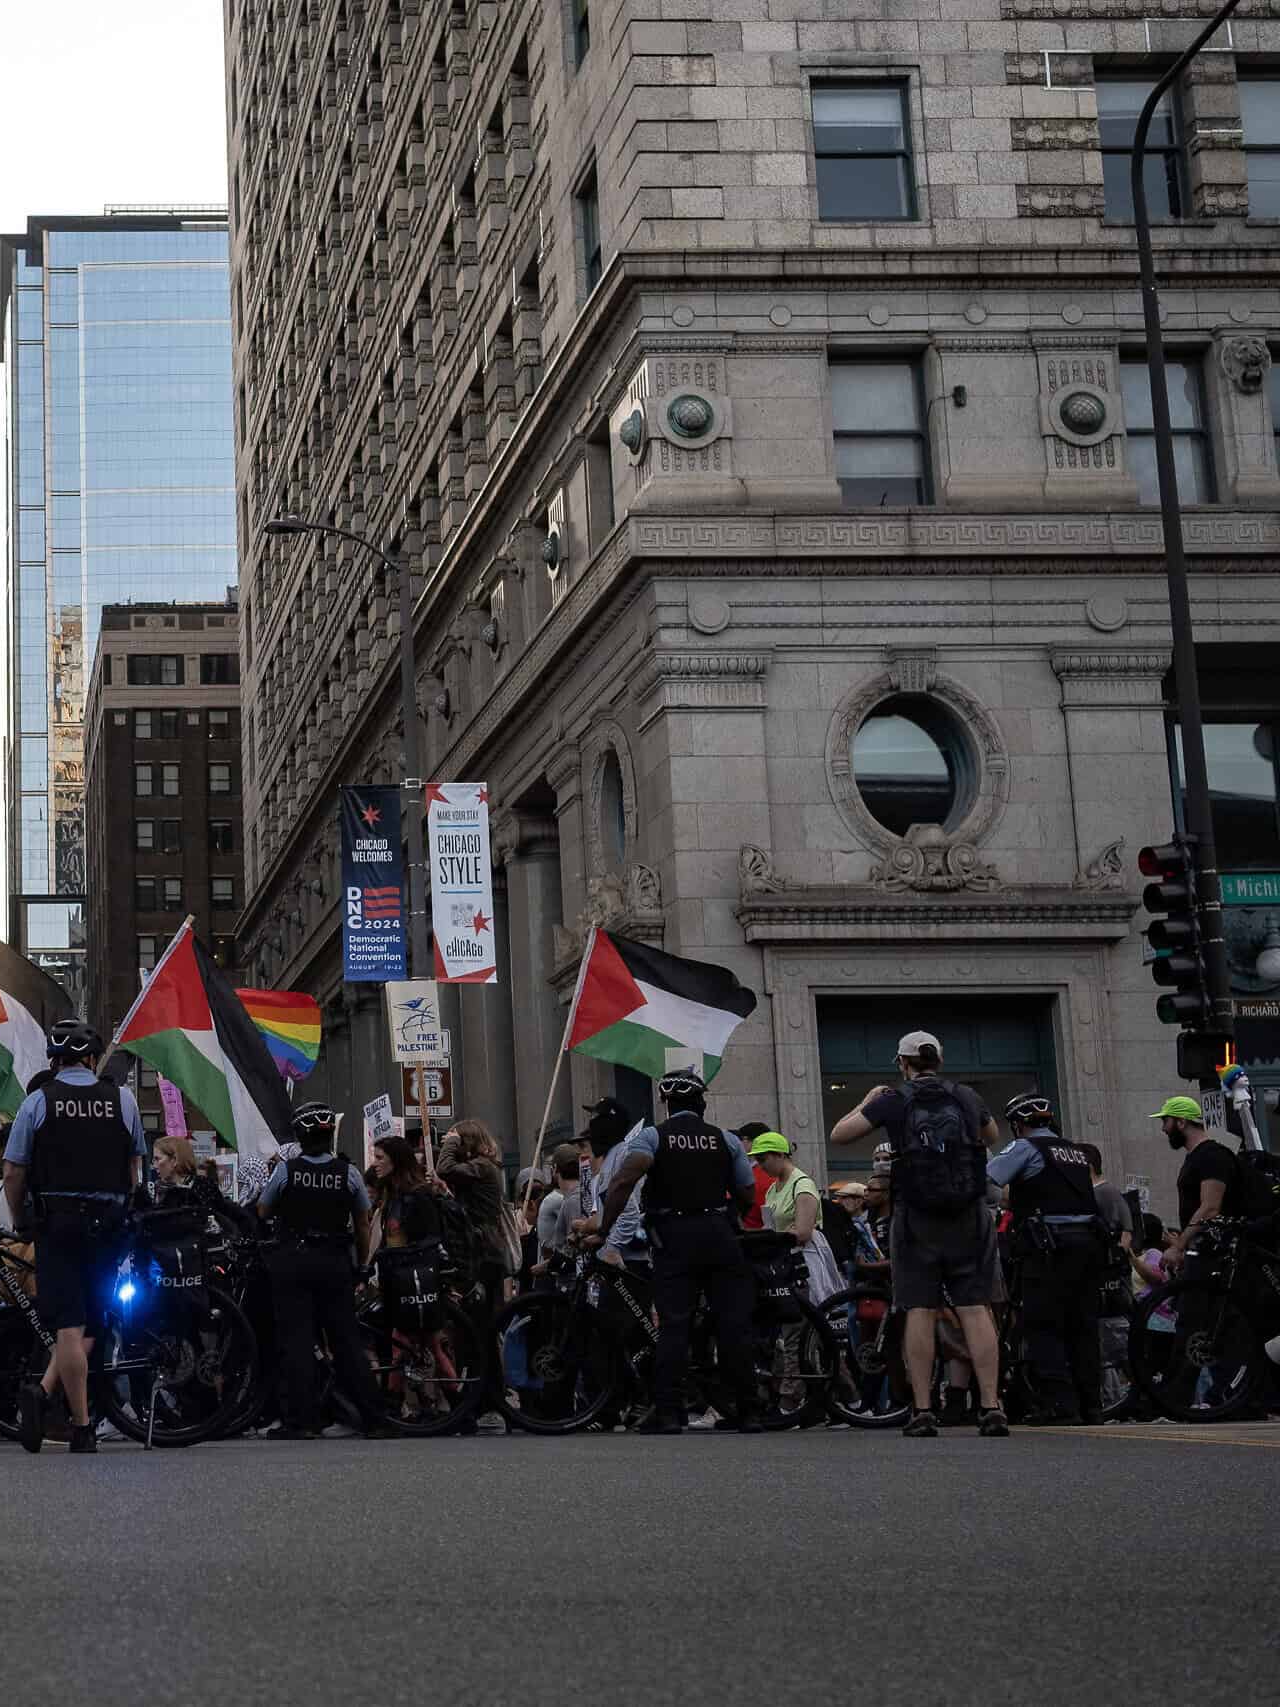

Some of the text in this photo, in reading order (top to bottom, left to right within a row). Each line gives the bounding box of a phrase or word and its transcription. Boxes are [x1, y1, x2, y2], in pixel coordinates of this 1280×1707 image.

[355, 839, 388, 850] CHICAGO
[437, 834, 481, 854] CHICAGO
[351, 850, 393, 862] WELCOMES
[439, 856, 482, 885] STYLE
[347, 886, 362, 929] DNC
[365, 920, 400, 929] 2024
[349, 934, 401, 943] Democratic
[349, 943, 387, 952] National
[349, 953, 401, 961] Convention
[416, 1033, 438, 1041] FREE
[397, 1043, 438, 1051] PALESTINE
[55, 1100, 115, 1118] POLICE
[668, 1135, 718, 1150] POLICE
[1049, 1147, 1088, 1165] POLICE
[293, 1171, 342, 1190] POLICE
[156, 1275, 203, 1288] POLICE
[0, 1265, 54, 1346] CHICAGO POLICE
